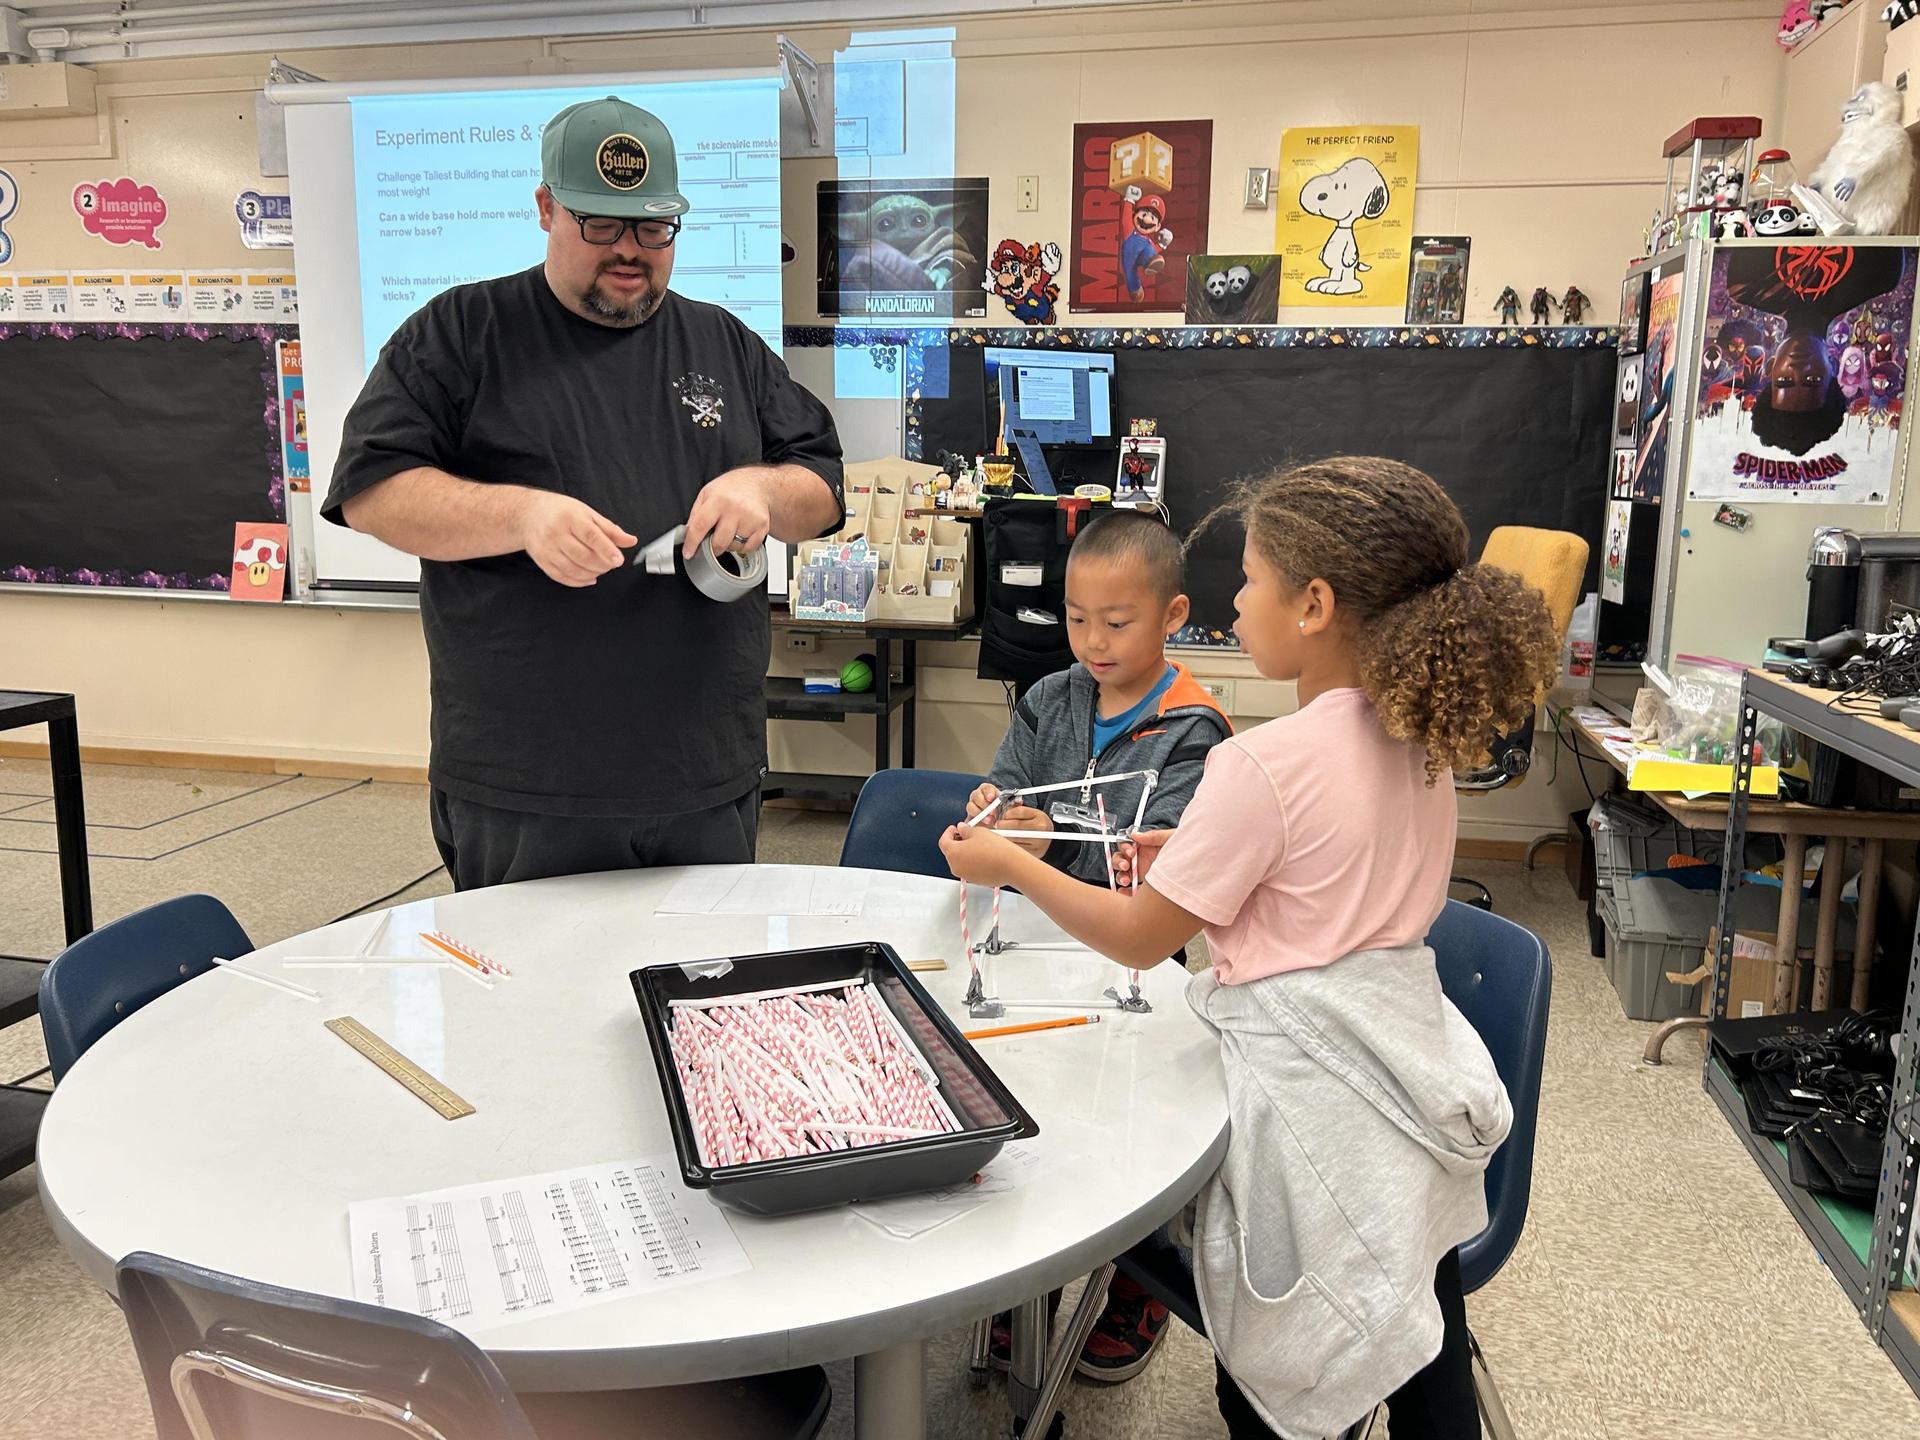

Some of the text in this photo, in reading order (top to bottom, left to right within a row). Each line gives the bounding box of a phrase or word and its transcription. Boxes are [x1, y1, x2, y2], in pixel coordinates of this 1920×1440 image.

[376, 128, 464, 150] Experiment
[470, 126, 516, 143] Rules
[520, 124, 532, 141] &
[1306, 135, 1395, 145] THE PERFECT FRIEND
[602, 149, 644, 171] Sullen
[377, 170, 422, 184] Challenge
[423, 170, 452, 180] Tallest
[454, 168, 490, 182] Building
[492, 168, 510, 179] that
[512, 170, 528, 178] can
[378, 186, 430, 198] most weight
[84, 194, 162, 217] 2 Imagine
[246, 199, 290, 216] 3 Pla
[379, 212, 398, 222] Can
[400, 213, 406, 222] a
[408, 210, 430, 221] wide
[432, 210, 455, 221] base
[457, 210, 478, 220] hold
[480, 211, 504, 220] more
[1080, 136, 1121, 304] MARIO
[380, 226, 443, 238] narrow base?
[382, 276, 411, 286] Which
[413, 274, 450, 286] material
[382, 291, 416, 302] sticks?
[865, 296, 935, 313] MANDALORIAN
[1744, 482, 1771, 490] ACROSS
[1774, 481, 1785, 489] THE
